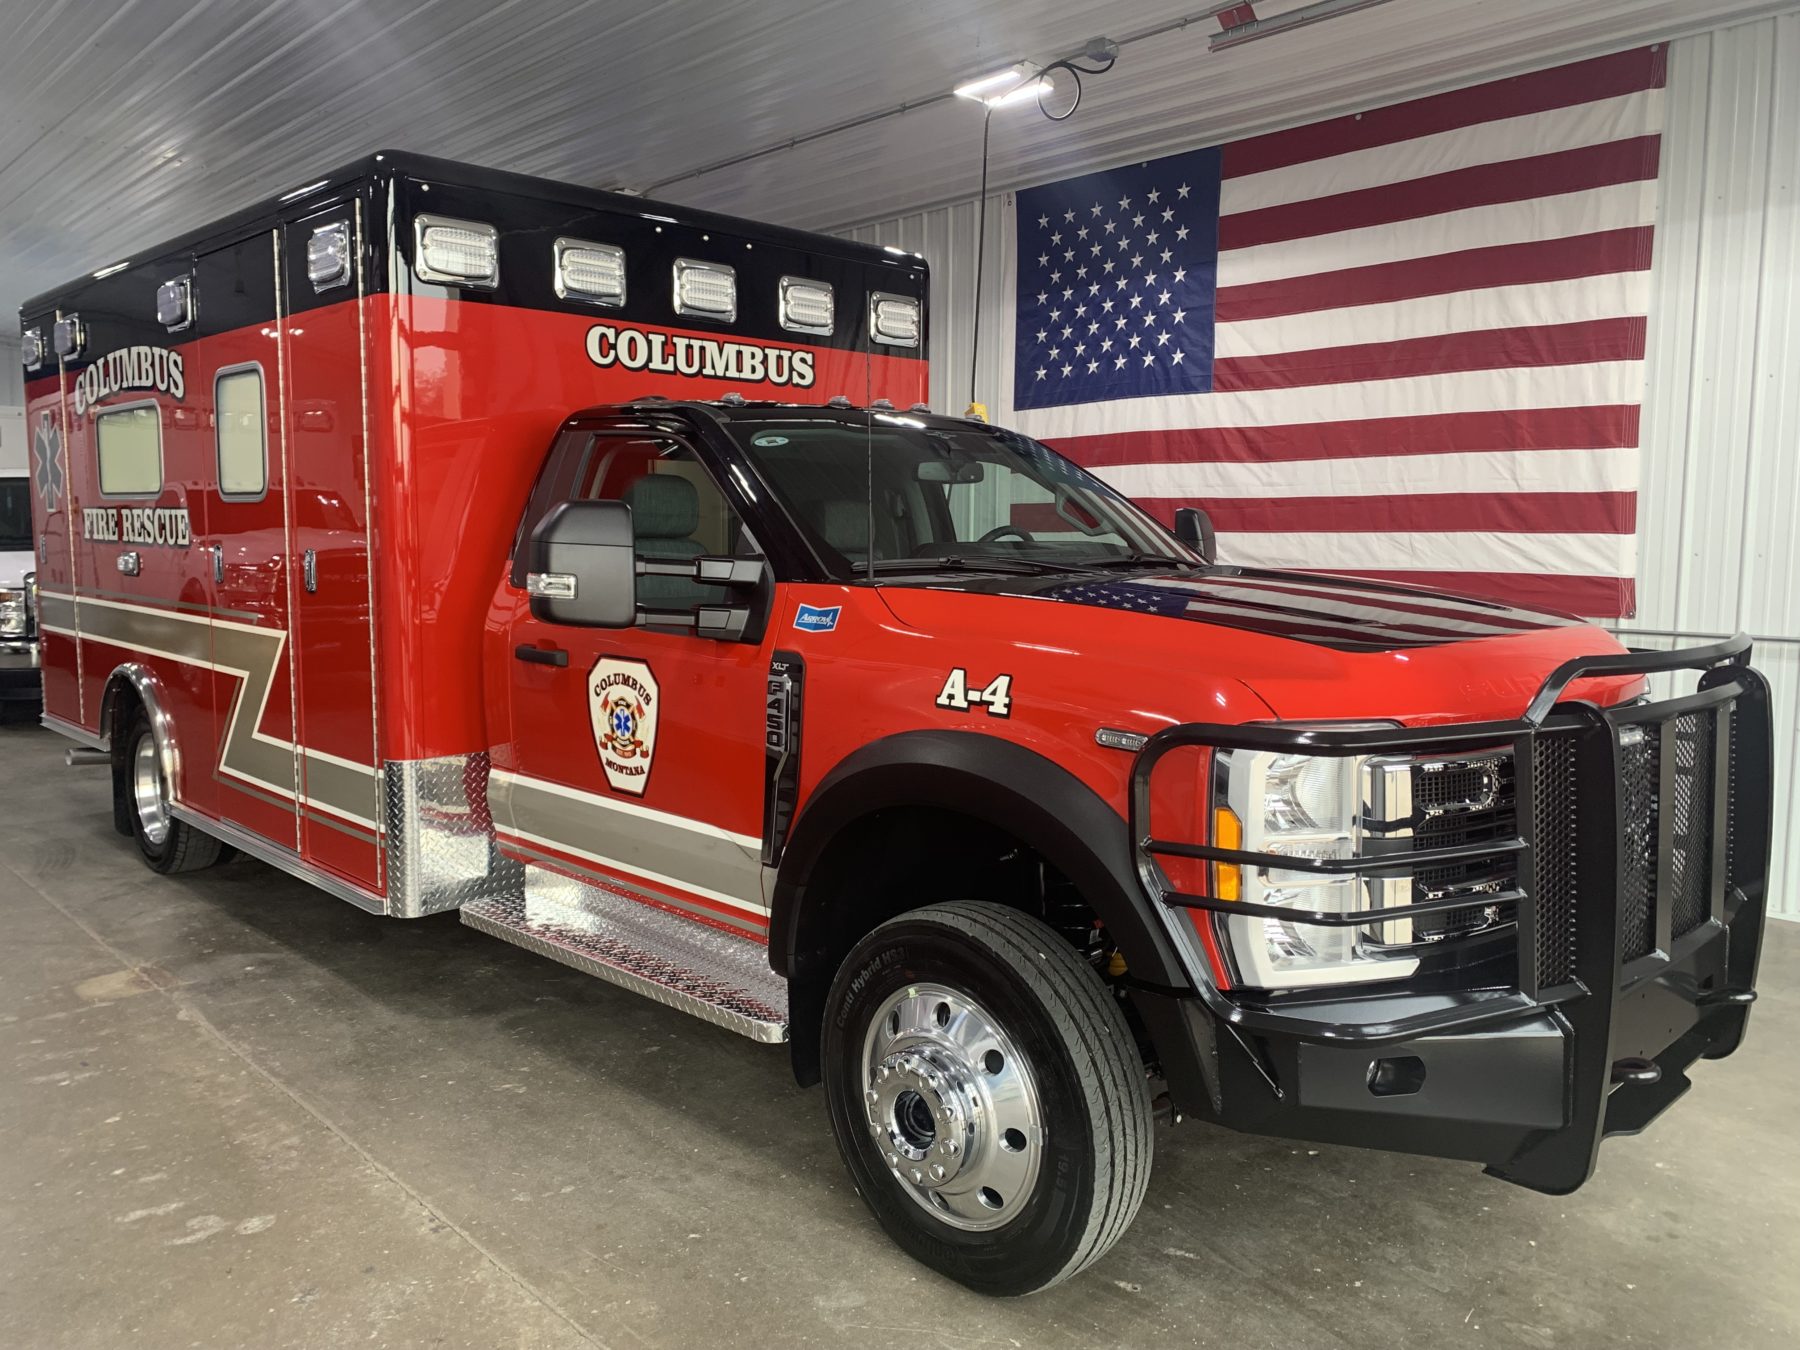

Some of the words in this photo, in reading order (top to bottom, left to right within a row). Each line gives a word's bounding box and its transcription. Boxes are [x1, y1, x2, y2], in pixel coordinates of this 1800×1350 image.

[585, 325, 815, 388] COLUMBUS
[75, 345, 184, 415] COLUMBUS
[83, 507, 119, 541] FIRE
[121, 507, 190, 546] RESCUE
[771, 661, 790, 671] XLT
[594, 672, 652, 706] COLUMBUS
[936, 668, 1012, 717] A-4
[605, 757, 646, 777] MONTANA
[837, 990, 855, 1028] Conti
[851, 956, 882, 993] Hybrid
